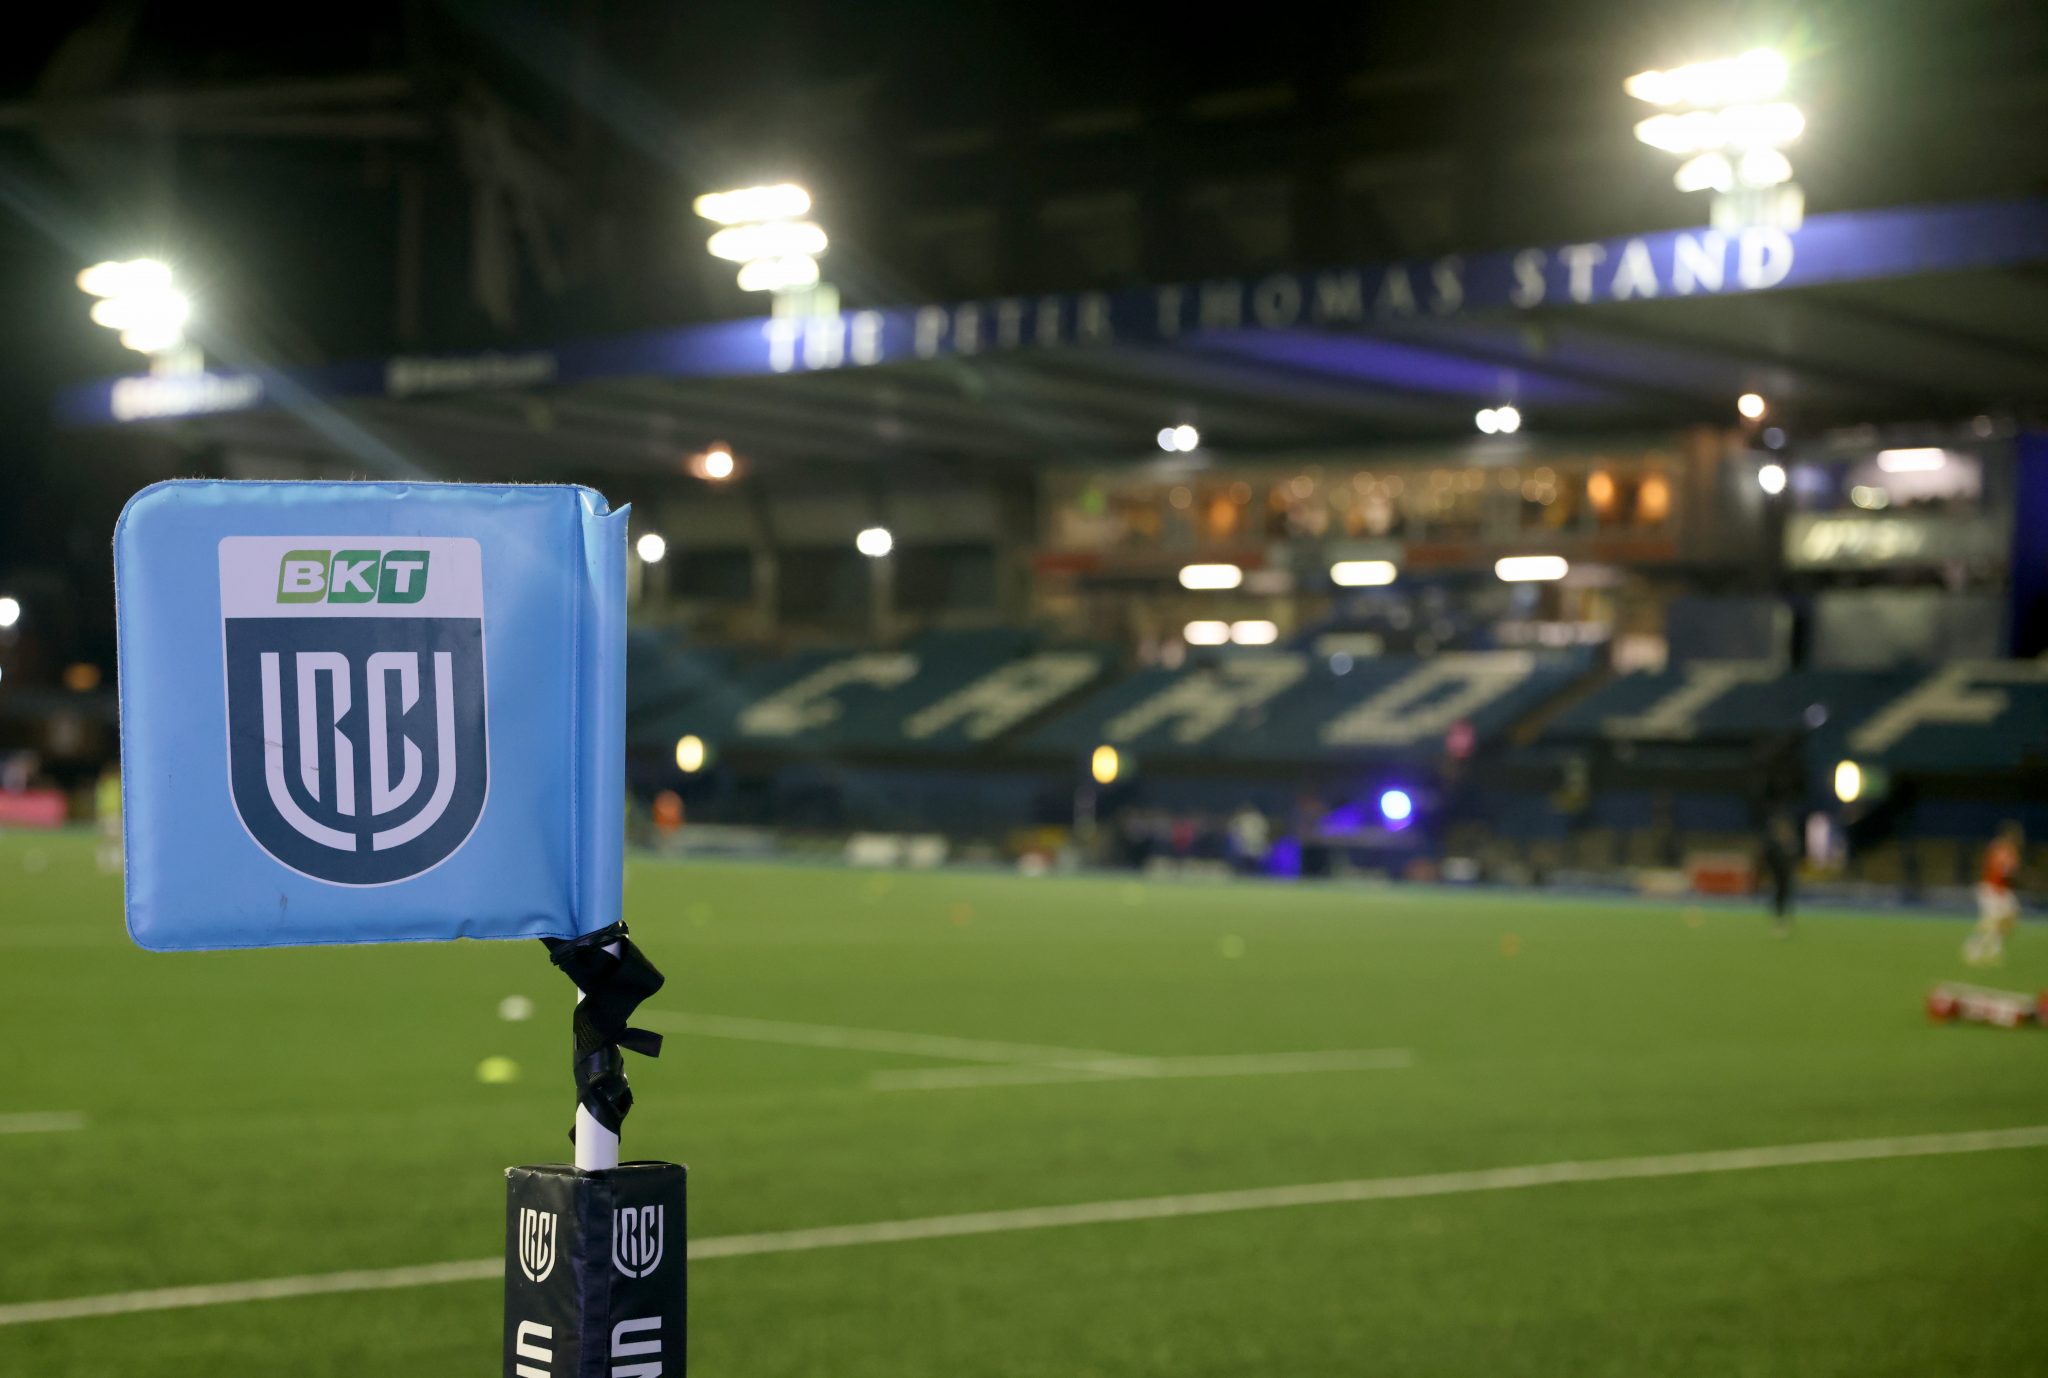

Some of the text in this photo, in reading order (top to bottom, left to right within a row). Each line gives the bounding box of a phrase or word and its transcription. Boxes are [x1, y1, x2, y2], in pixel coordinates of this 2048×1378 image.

[764, 226, 1796, 371] THE PETER THOMAS STAND
[282, 559, 424, 595] BKT
[260, 651, 457, 852] URC
